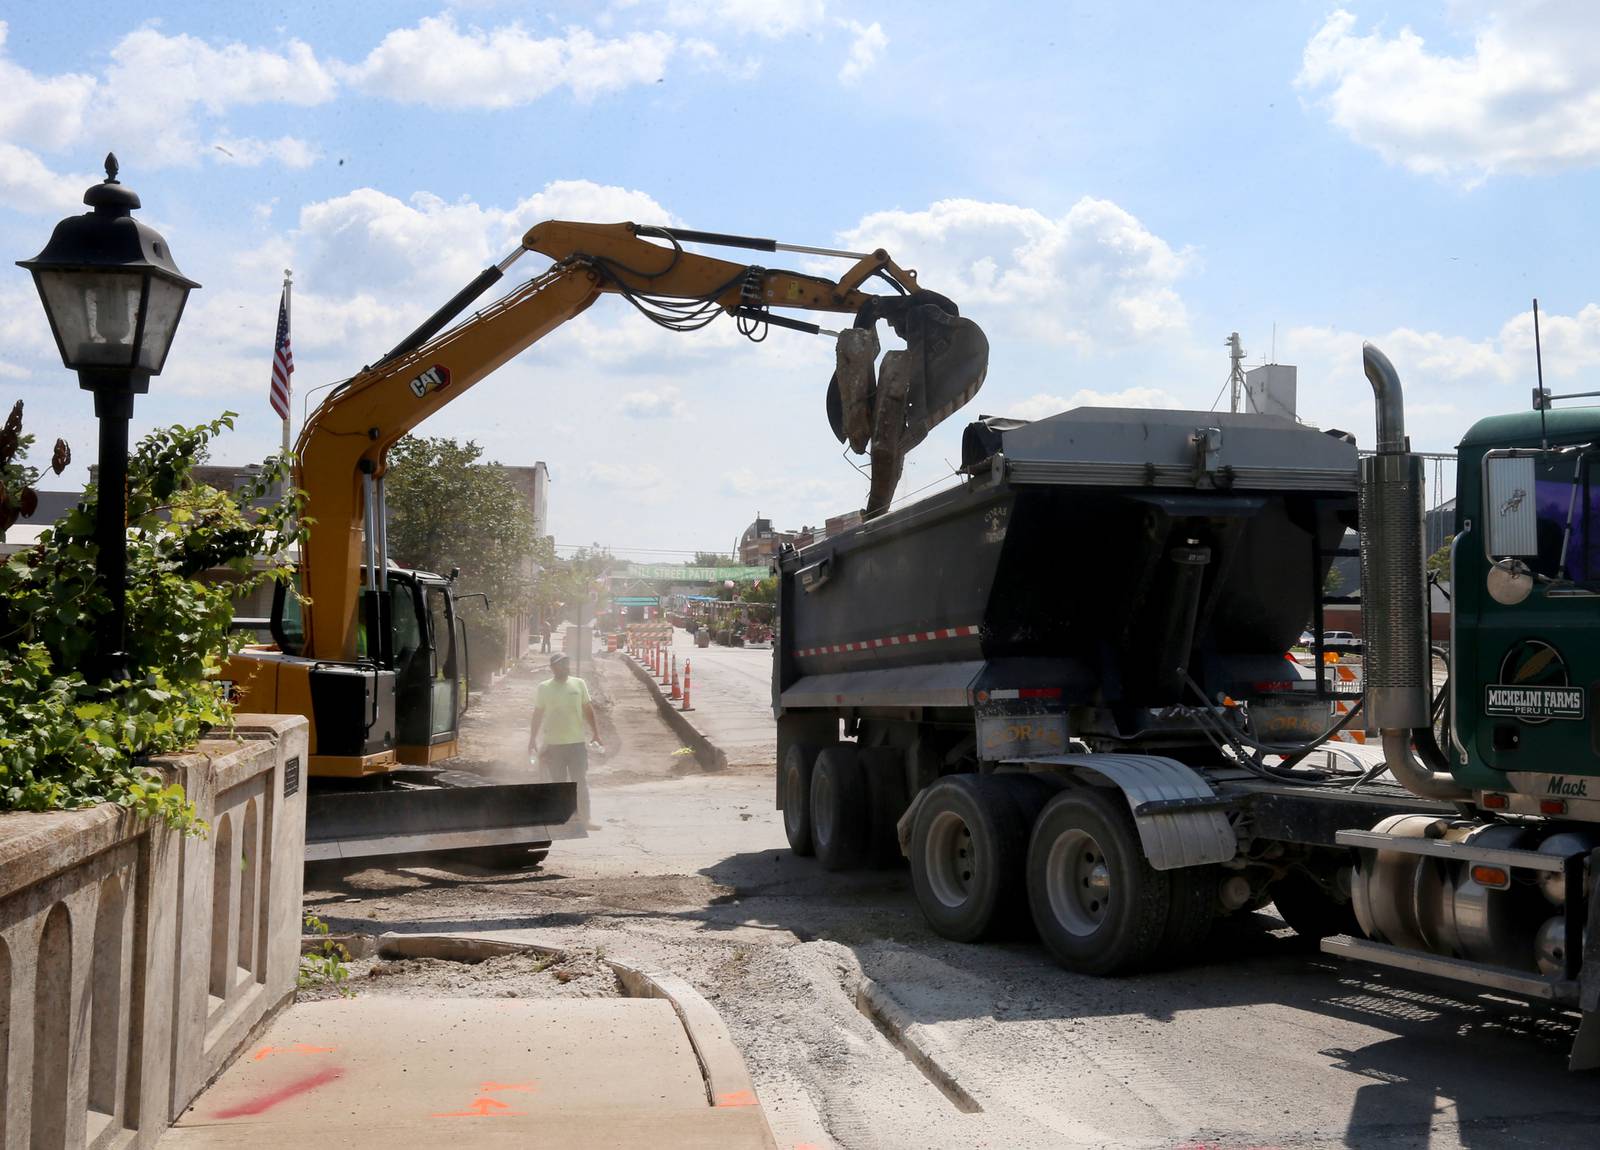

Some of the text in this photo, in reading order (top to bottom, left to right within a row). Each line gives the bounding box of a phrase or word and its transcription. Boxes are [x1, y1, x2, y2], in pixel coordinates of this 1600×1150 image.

[409, 367, 443, 398] CAT
[1488, 689, 1581, 708] MICHELINI FARMS
[1515, 706, 1553, 715] PERU IL
[1547, 775, 1588, 797] Mack
